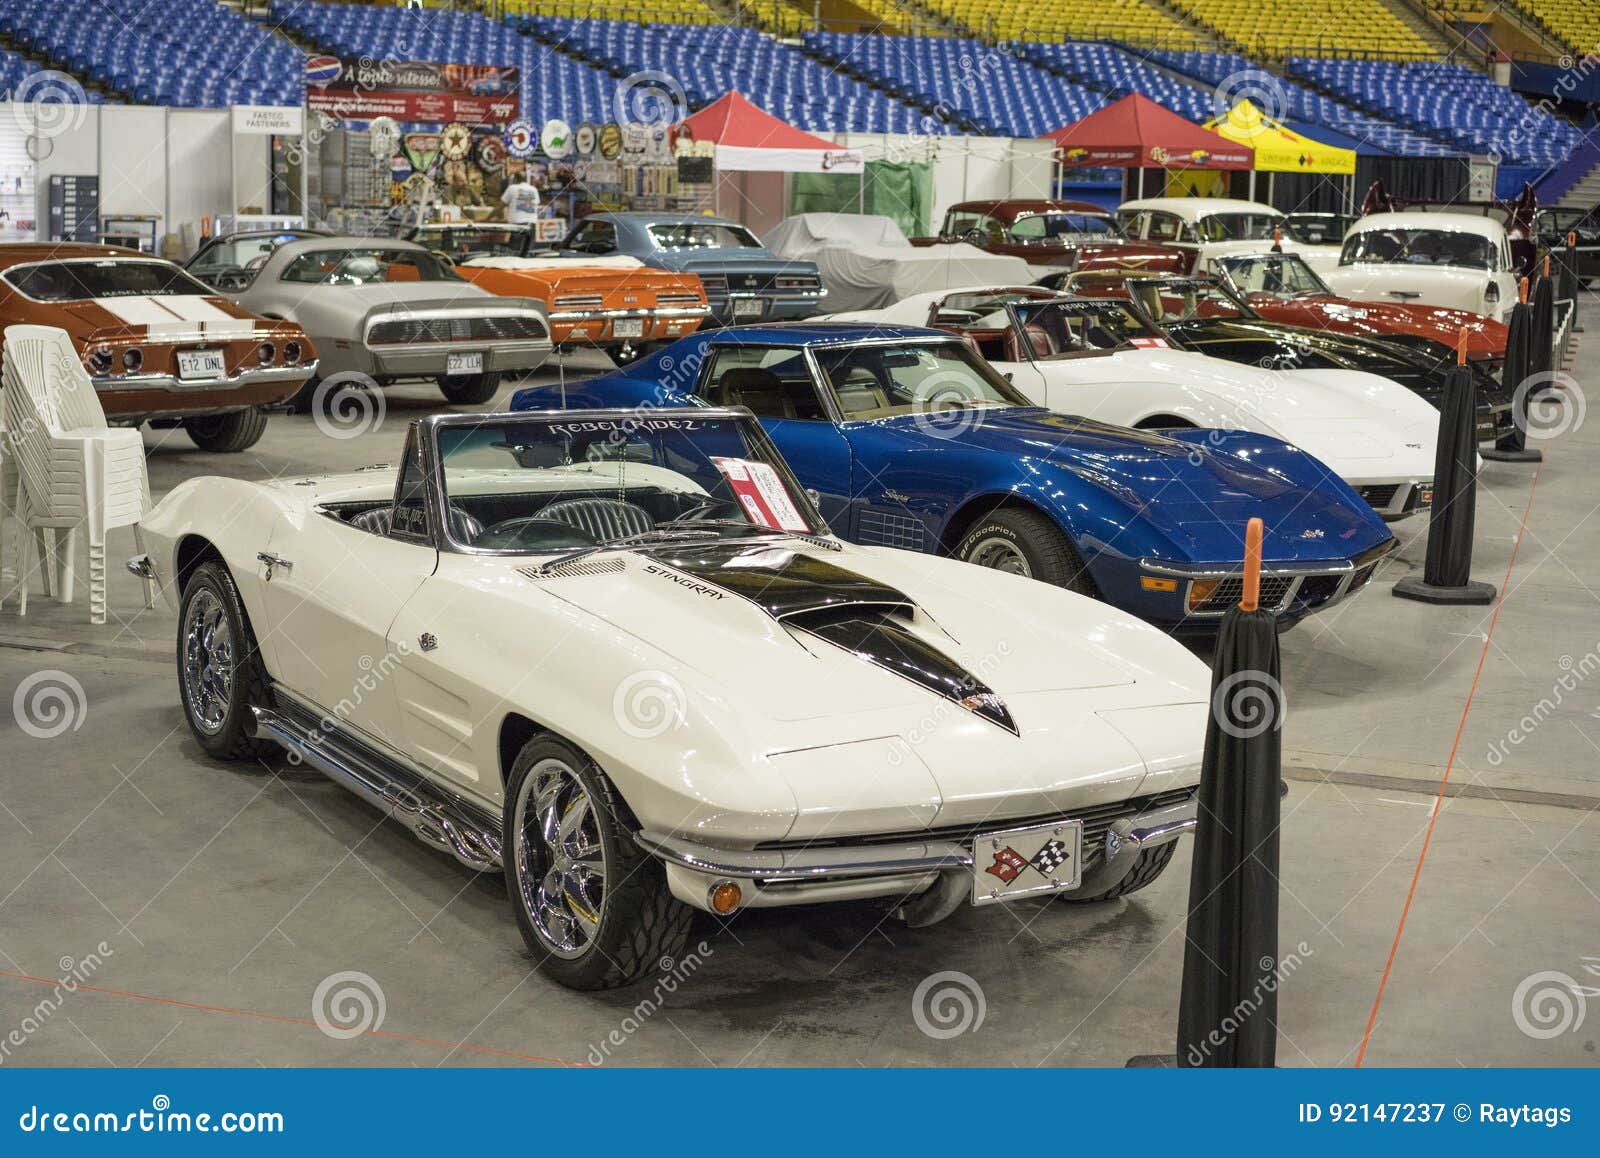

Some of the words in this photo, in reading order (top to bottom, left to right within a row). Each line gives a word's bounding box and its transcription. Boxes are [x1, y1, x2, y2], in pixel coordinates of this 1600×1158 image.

[204, 357, 223, 371] DNL
[549, 421, 624, 438] REBEL
[632, 420, 700, 434] RIDEZ
[642, 565, 729, 600] STINGRAY
